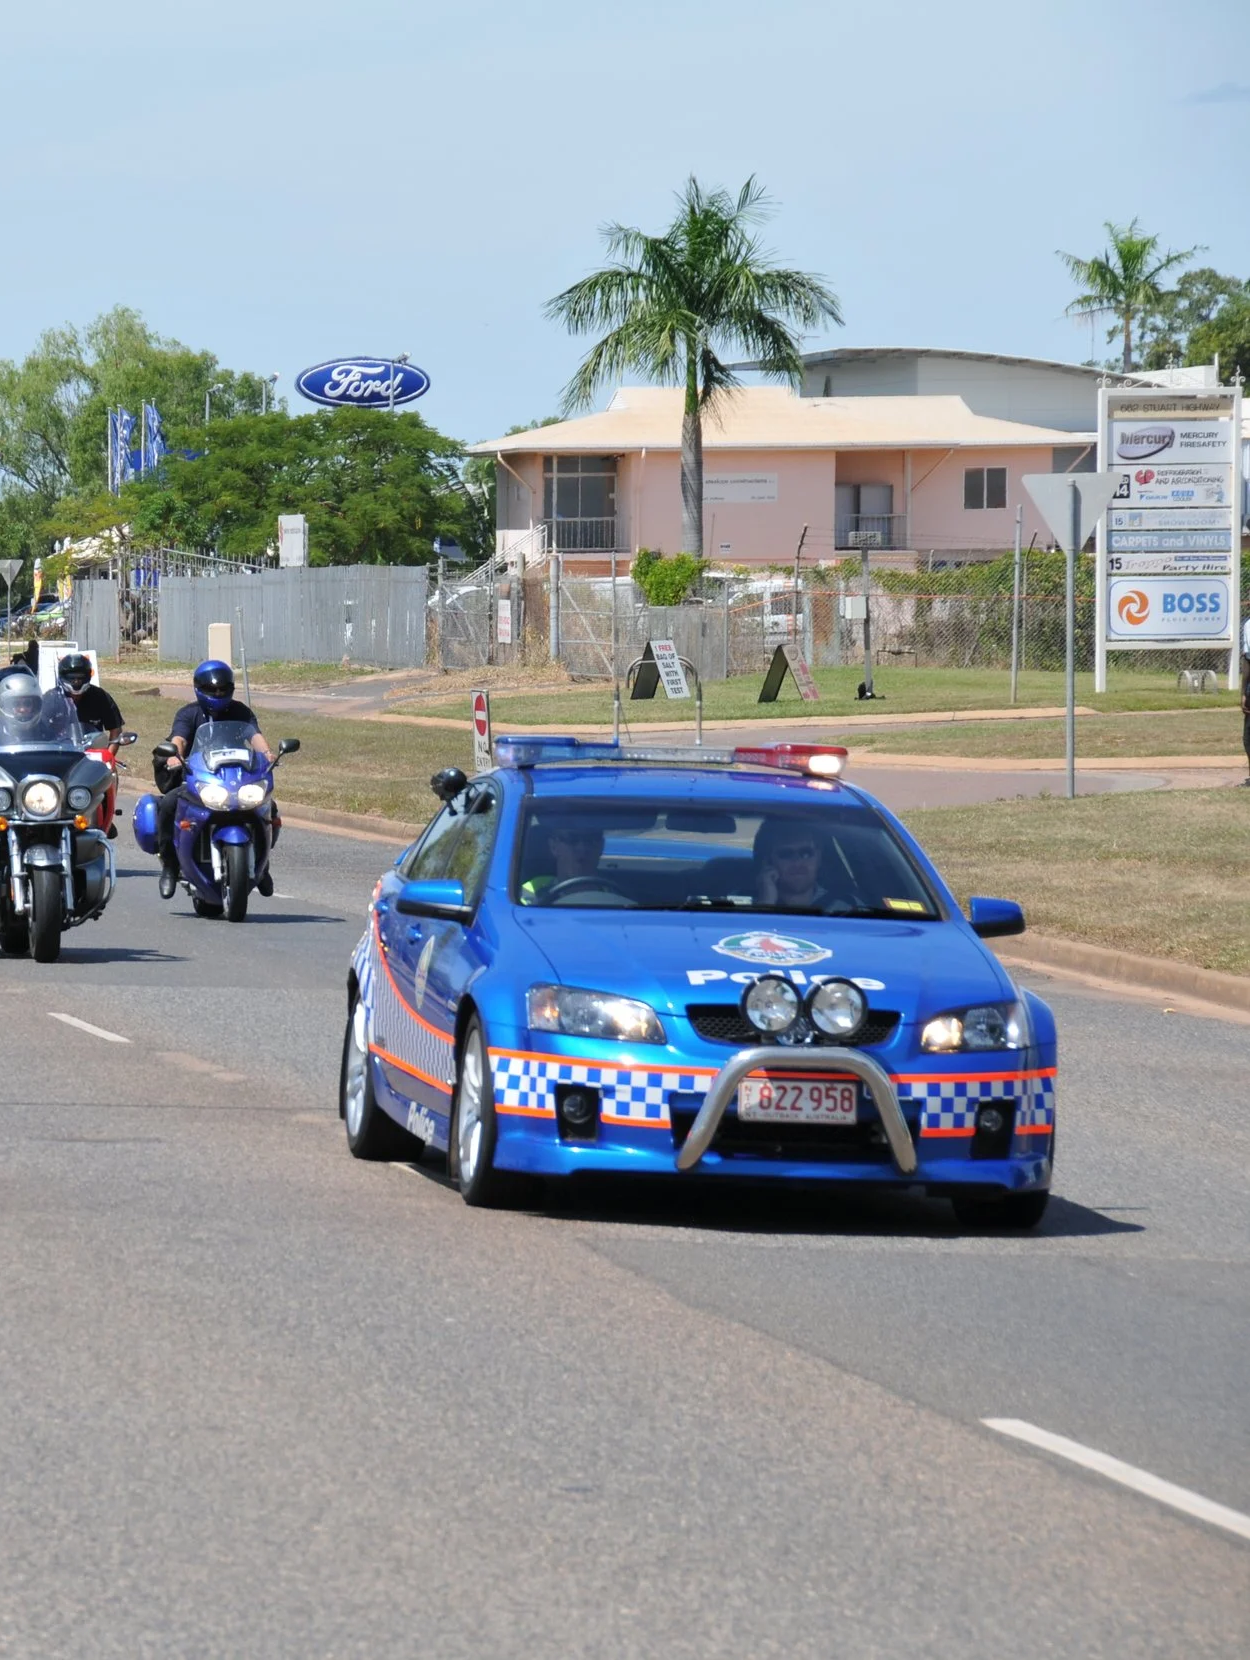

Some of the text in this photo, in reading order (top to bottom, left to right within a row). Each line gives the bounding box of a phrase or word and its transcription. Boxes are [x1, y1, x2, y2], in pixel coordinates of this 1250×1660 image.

[324, 365, 404, 397] Ford
[1143, 403, 1177, 412] STUART
[1181, 403, 1221, 411] HIGHWAY
[1120, 430, 1175, 448] Mercury
[1116, 484, 1129, 497] 14
[1115, 517, 1124, 526] 15
[1112, 535, 1226, 547] CARPETS and VINYLS
[1109, 557, 1123, 570] 15
[1163, 592, 1221, 613] BOSS
[478, 740, 487, 752] NO
[407, 1101, 434, 1143] Police
